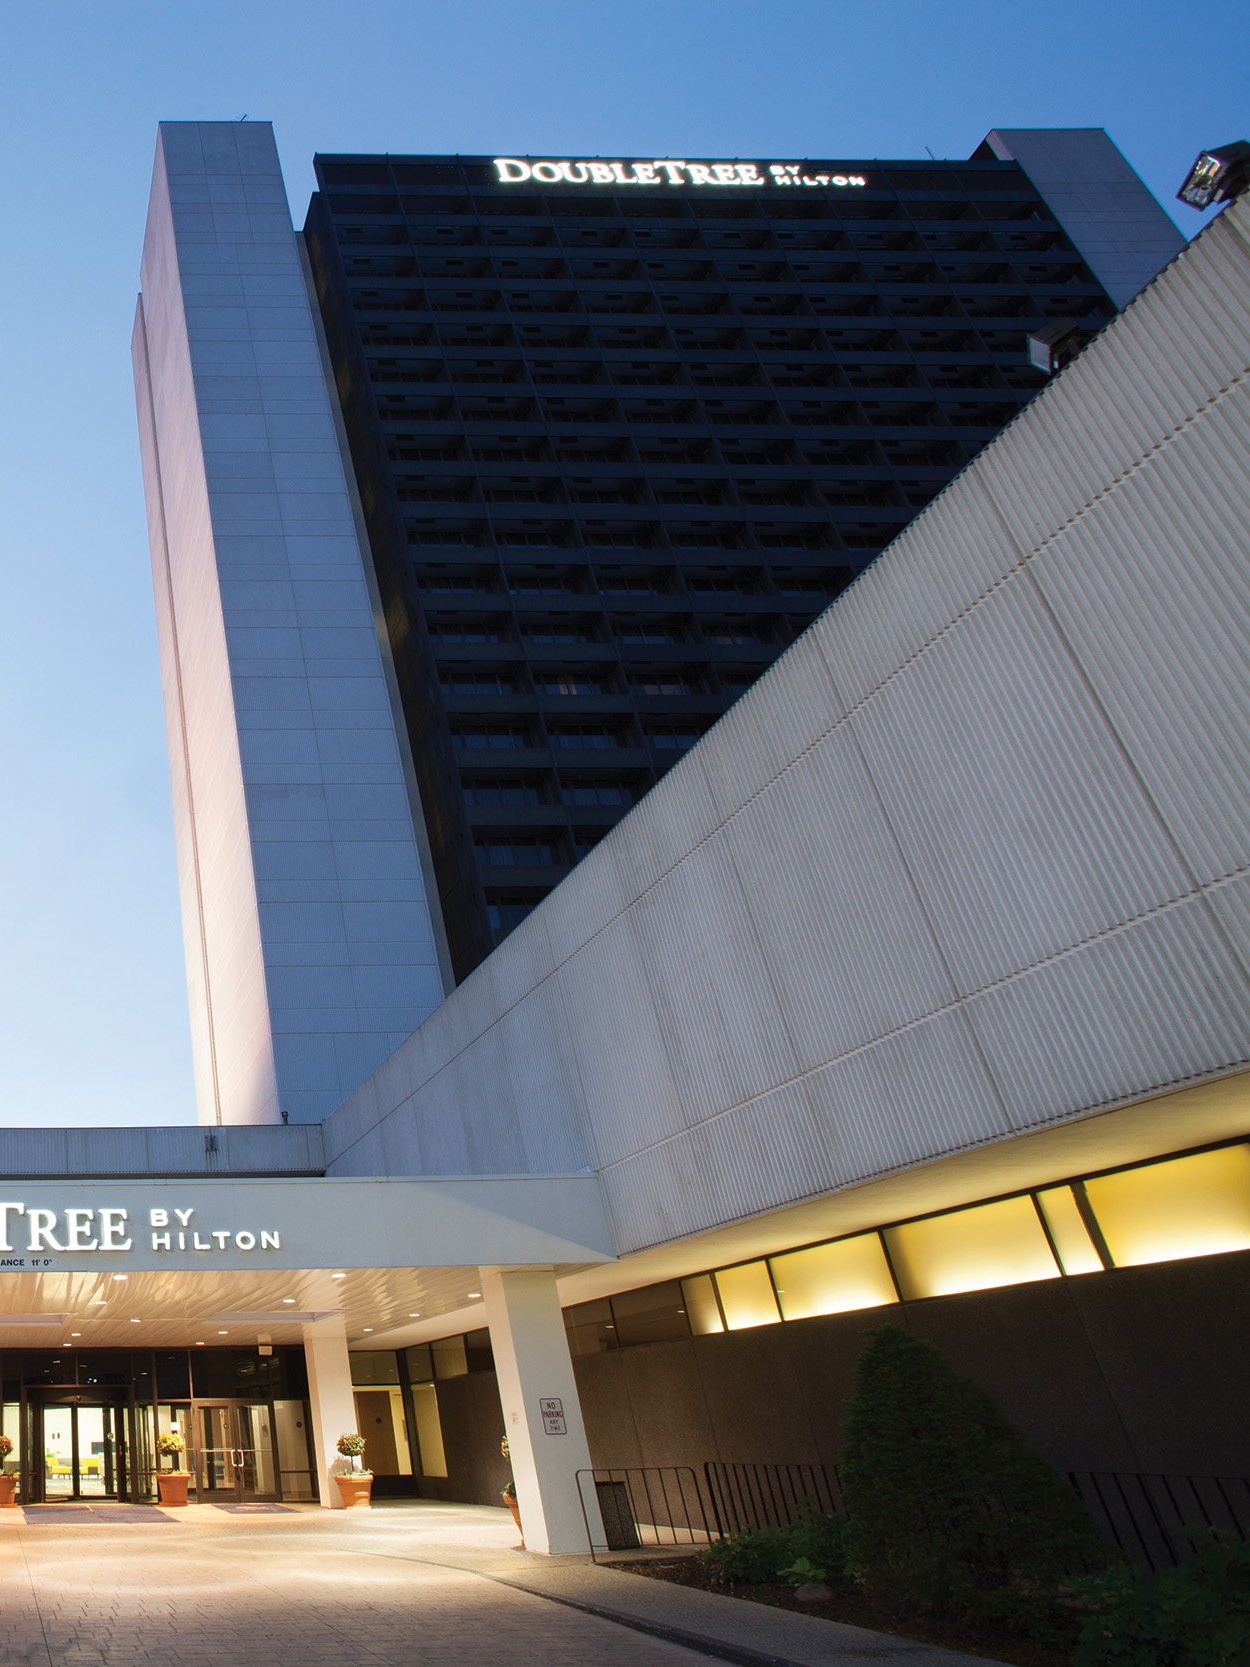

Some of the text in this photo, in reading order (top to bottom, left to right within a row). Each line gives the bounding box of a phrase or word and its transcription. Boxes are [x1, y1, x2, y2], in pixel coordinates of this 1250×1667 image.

[769, 165, 800, 176] BY
[774, 175, 866, 186] HILTON
[150, 1208, 194, 1227] BY
[151, 1230, 281, 1251] HILTON
[546, 1402, 556, 1410] NO
